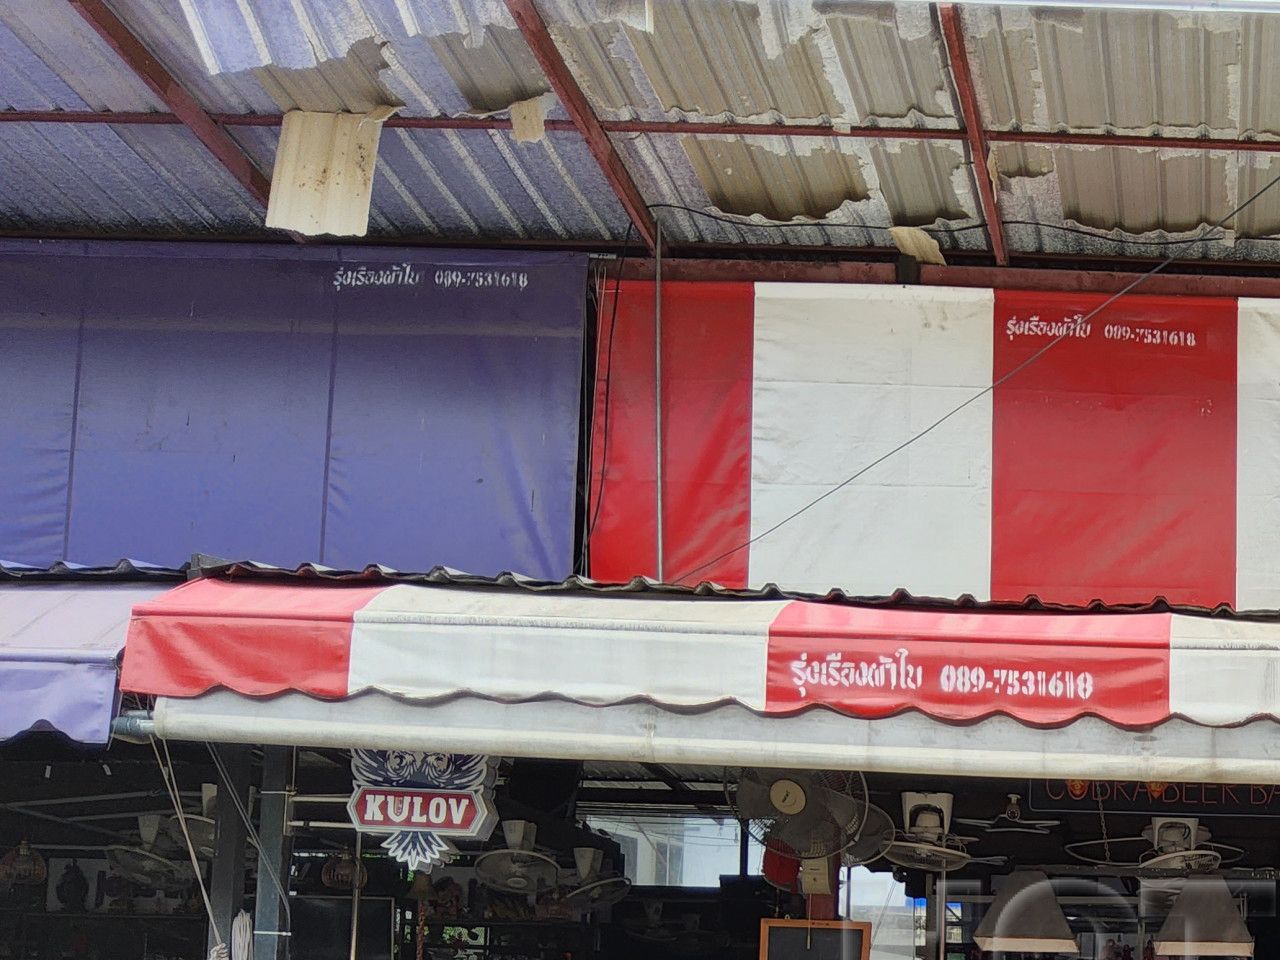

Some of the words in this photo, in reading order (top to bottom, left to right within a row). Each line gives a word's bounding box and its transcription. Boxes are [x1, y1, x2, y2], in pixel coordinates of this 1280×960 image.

[434, 270, 529, 289] 089-7531618
[1104, 323, 1196, 346] 089-7531618
[940, 664, 1094, 700] 089-7531618
[364, 794, 470, 825] KULOV
